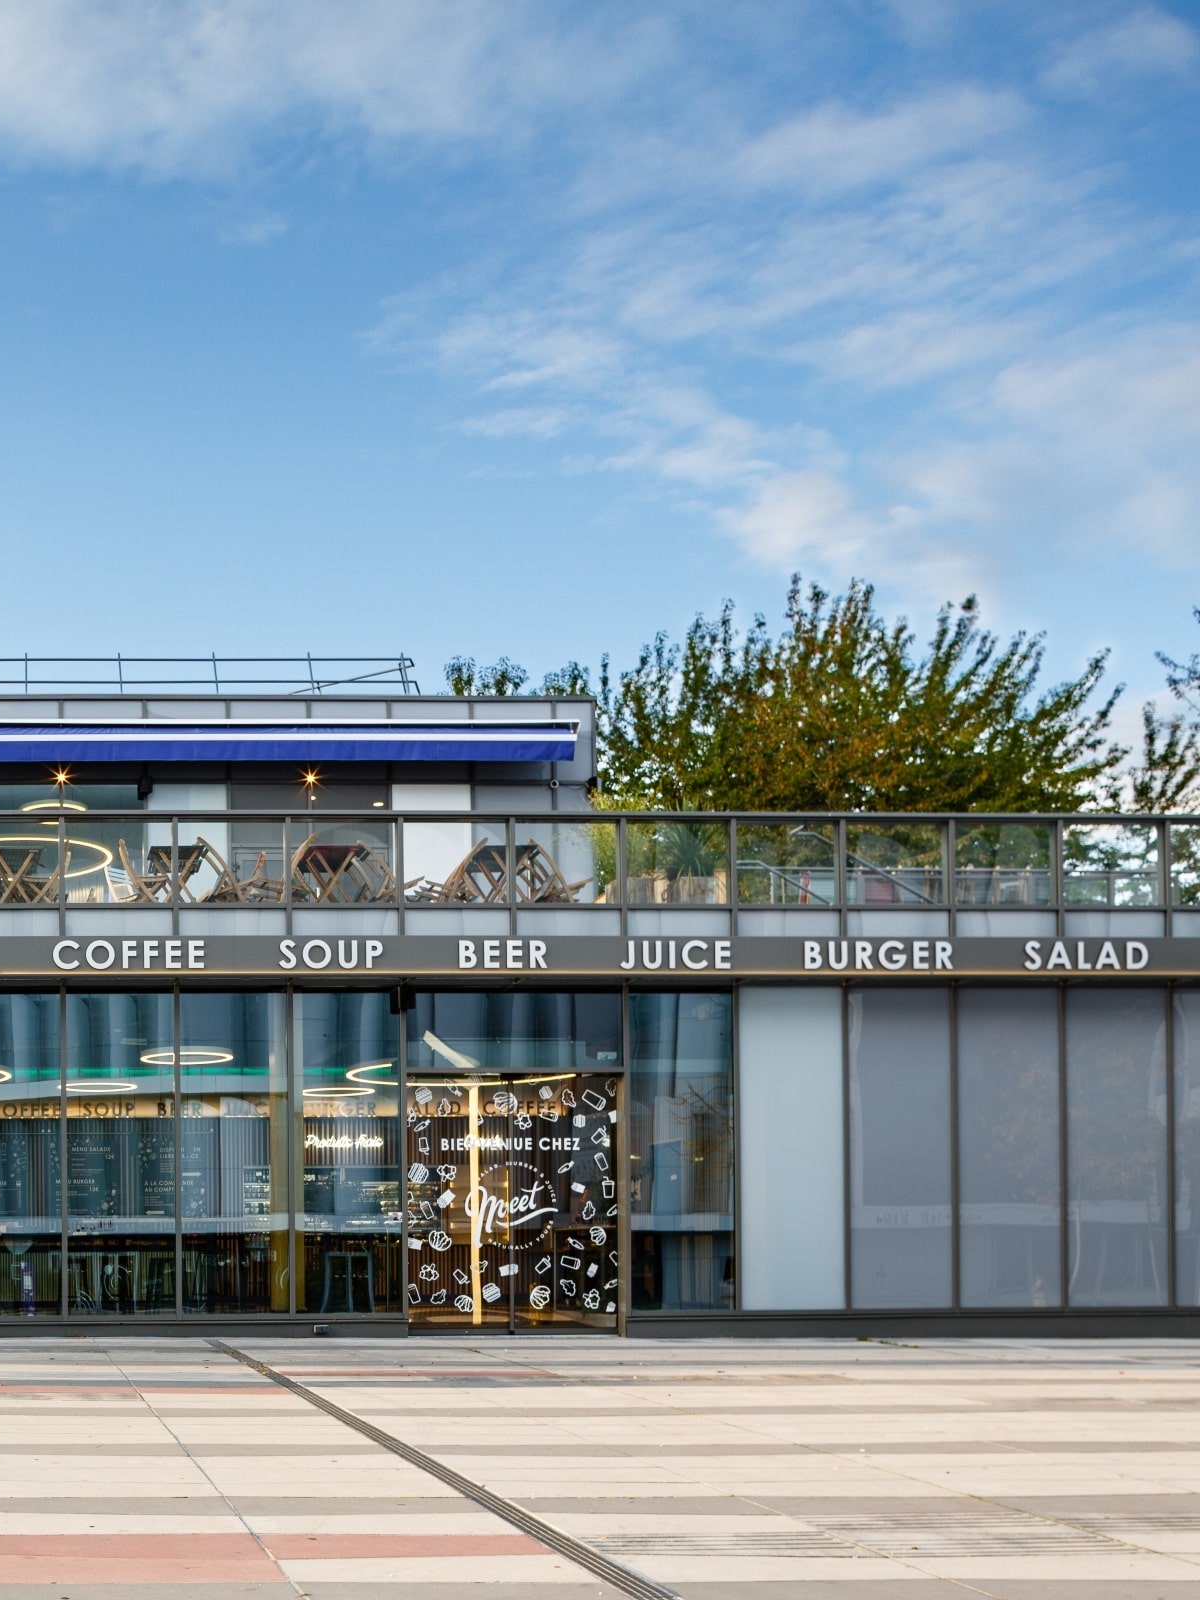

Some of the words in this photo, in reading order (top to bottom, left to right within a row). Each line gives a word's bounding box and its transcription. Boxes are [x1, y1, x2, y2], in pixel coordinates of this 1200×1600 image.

[52, 939, 206, 970] COFFEE
[278, 939, 384, 970] SOUP
[458, 939, 548, 970] BEER
[620, 939, 733, 971] JUICE
[803, 940, 954, 971] BURGER
[1024, 940, 1150, 971] SALAD
[82, 1102, 135, 1117] SOUP
[538, 1137, 581, 1151] CHEZ
[544, 1180, 557, 1203] JUICE
[535, 1220, 554, 1242] YOURS
